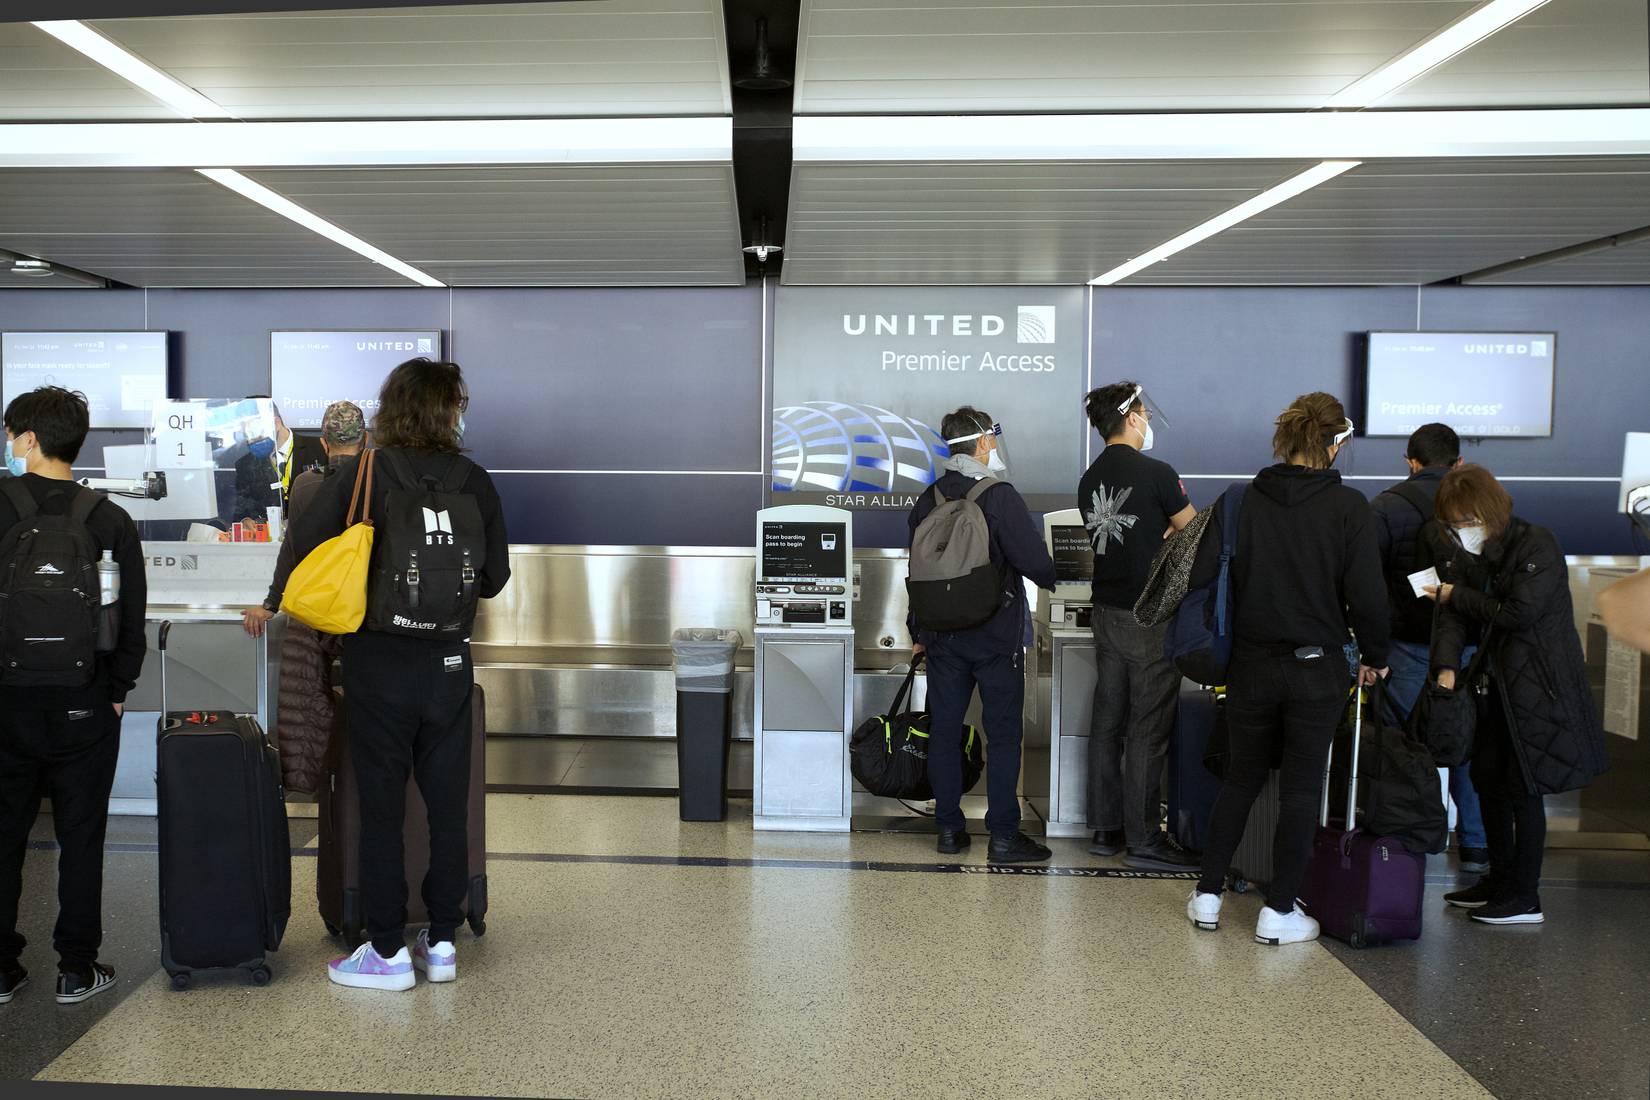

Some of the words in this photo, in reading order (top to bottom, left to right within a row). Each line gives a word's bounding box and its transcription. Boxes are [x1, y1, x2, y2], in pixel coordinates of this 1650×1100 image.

[843, 314, 1005, 336] UNITED
[356, 341, 414, 351] UNITED
[1464, 344, 1528, 354] UNITED
[881, 351, 971, 372] Premier
[979, 351, 1055, 372] Access
[1381, 401, 1442, 416] Premier
[168, 414, 193, 431] QH
[177, 442, 186, 457] 1
[825, 494, 866, 506] STAR
[870, 494, 918, 507] ALLIA
[425, 535, 454, 545] BTS
[1077, 544, 1092, 552] begi
[144, 556, 176, 567] TED
[959, 866, 1015, 874] Help
[1069, 868, 1098, 876] by
[1106, 870, 1202, 879] spreadi
